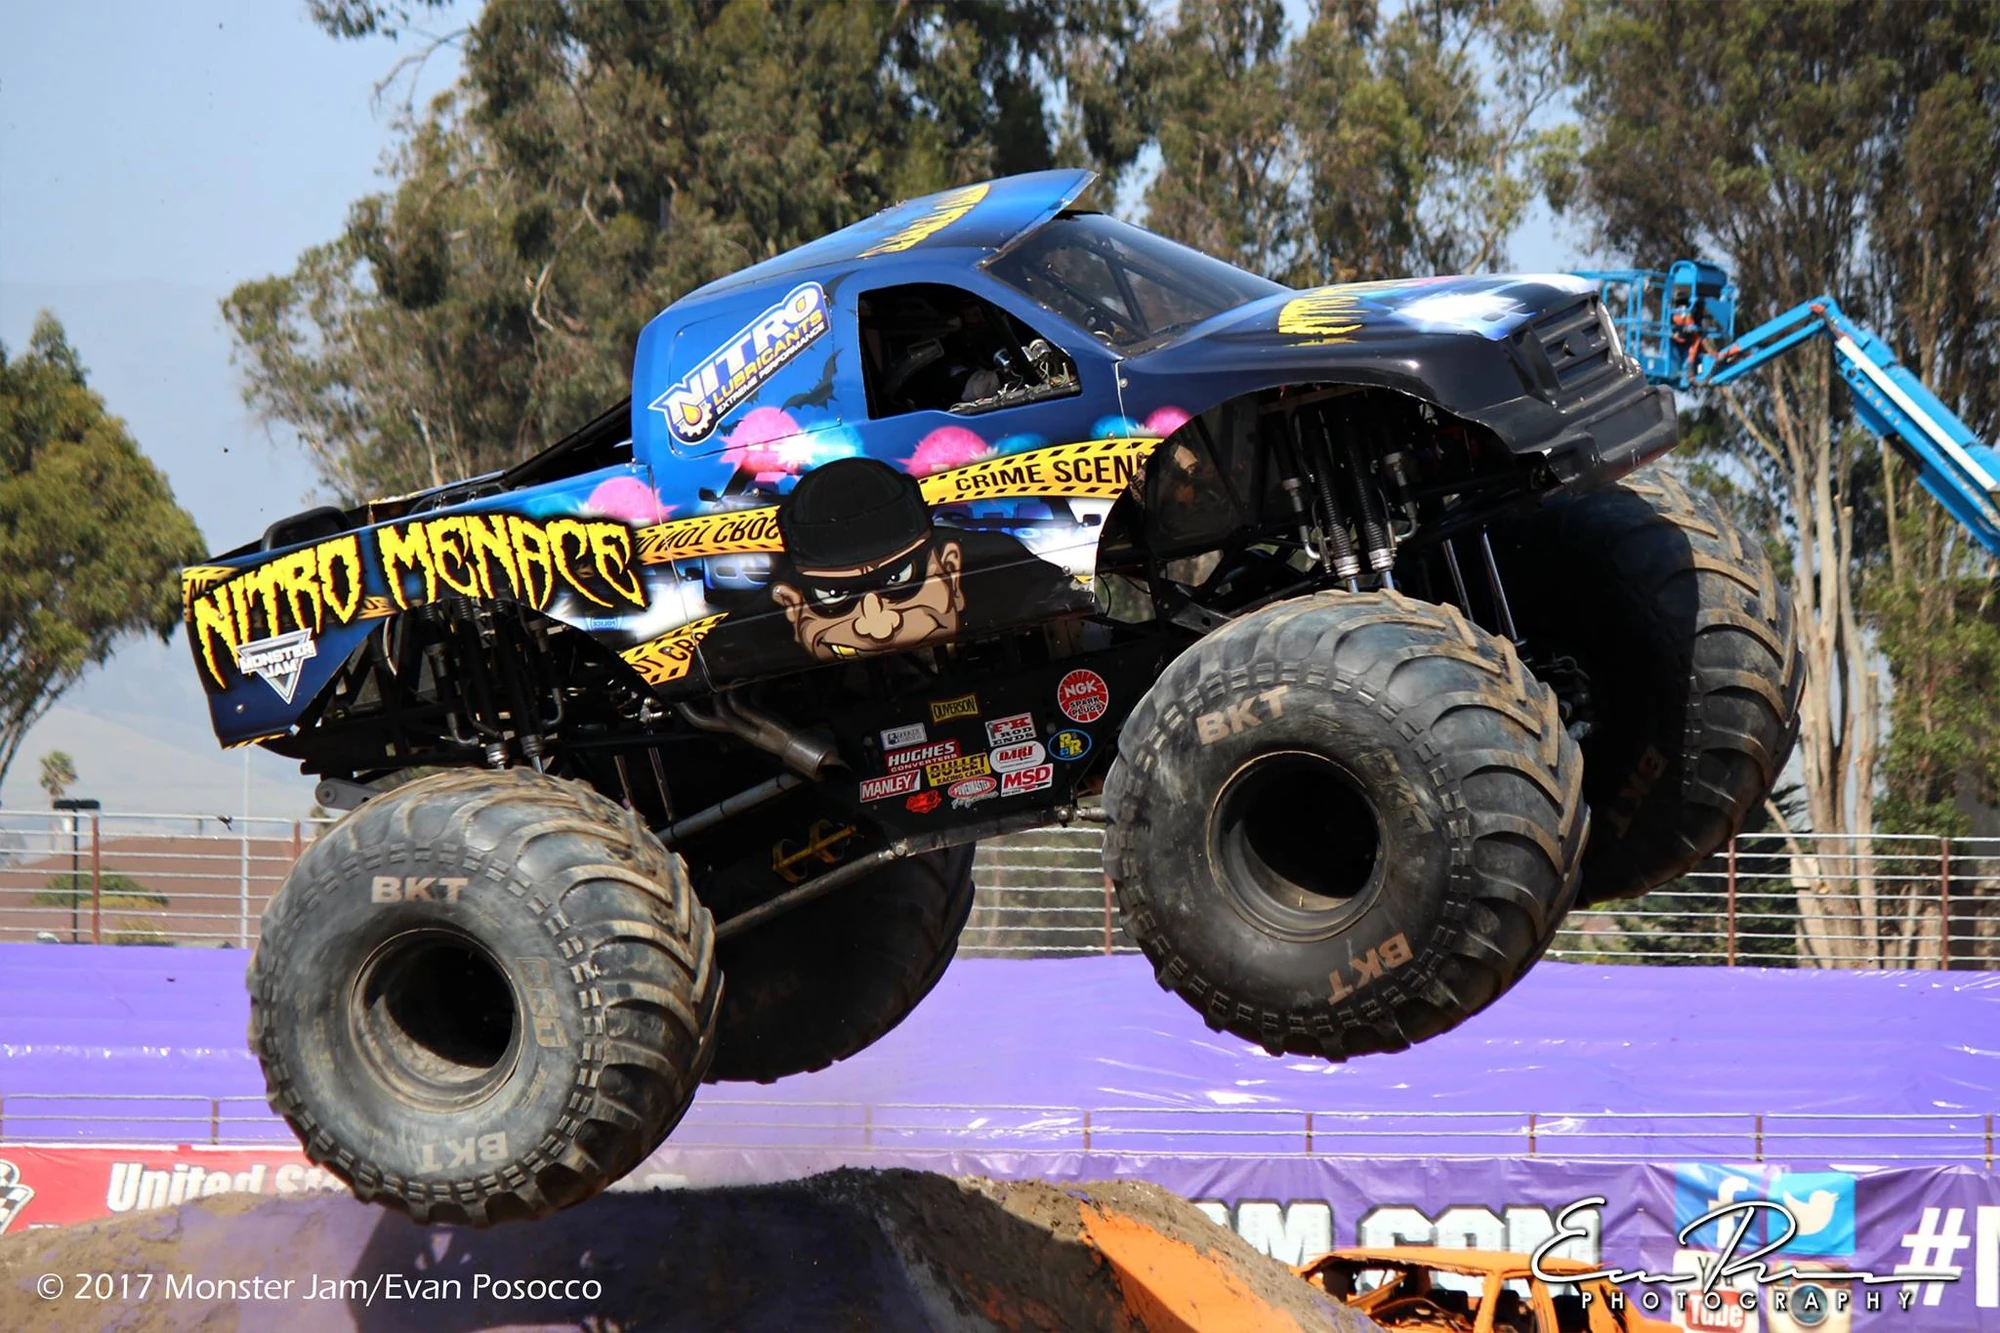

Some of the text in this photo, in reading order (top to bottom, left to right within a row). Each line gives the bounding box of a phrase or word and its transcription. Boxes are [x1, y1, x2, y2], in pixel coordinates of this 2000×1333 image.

[664, 287, 820, 422] NITRO
[713, 309, 824, 406] LUBRICANTS
[716, 323, 825, 415] EXTREME PERFORMANCE
[955, 454, 1149, 491] CRIME SCEN
[193, 514, 648, 690] NITRO MENACE
[239, 641, 315, 671] MONSTER
[264, 660, 299, 679] JAM
[1064, 680, 1098, 698] NGK
[1070, 695, 1100, 709] SPARK
[1071, 703, 1102, 717] PLUGS
[1195, 684, 1289, 746] BKT
[992, 733, 1034, 746] ENDS
[1001, 726, 1033, 738] ROD
[887, 741, 956, 767] HUGHES
[890, 752, 958, 773] CONVERTERS
[930, 754, 987, 780] BULLET
[862, 773, 913, 799] MANLEY
[1003, 766, 1051, 789] MSD
[371, 875, 469, 904] BKT
[1327, 931, 1414, 1006] BKT
[415, 1130, 510, 1174] BKT
